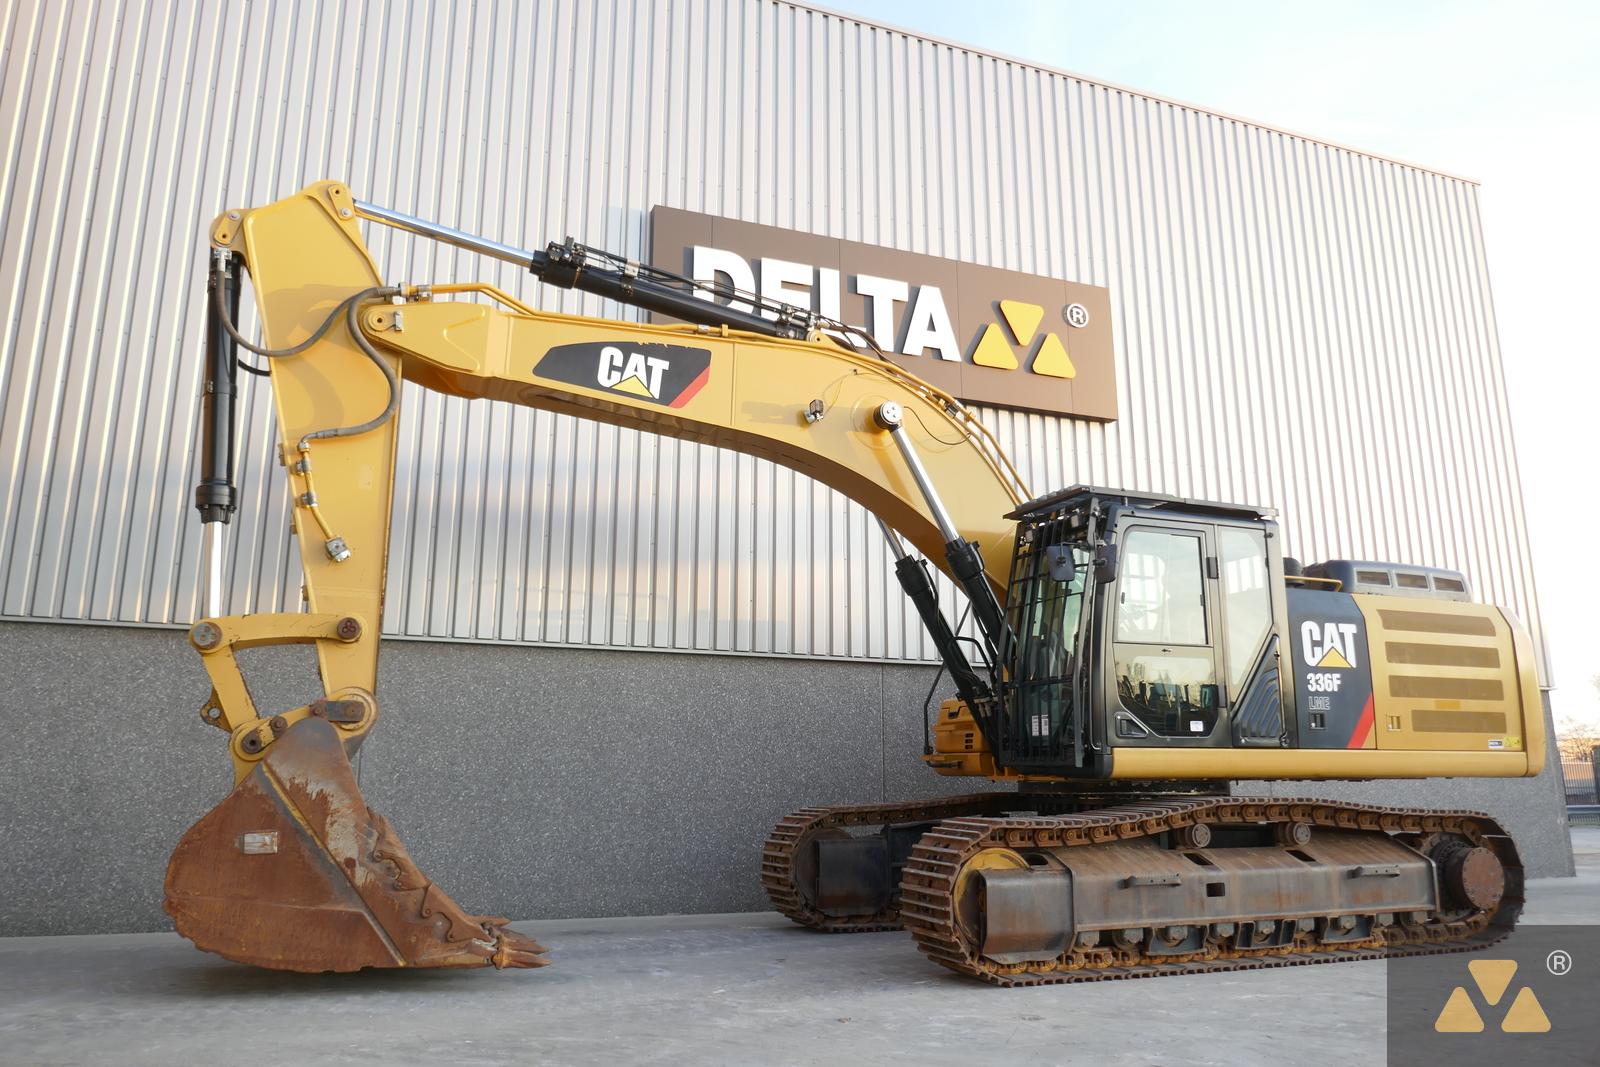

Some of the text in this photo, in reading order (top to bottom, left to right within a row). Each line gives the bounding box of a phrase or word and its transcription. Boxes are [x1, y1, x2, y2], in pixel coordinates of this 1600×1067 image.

[693, 245, 962, 362] DELTA
[597, 346, 670, 400] CAT
[1301, 620, 1358, 669] CAT
[1306, 672, 1342, 692] 336F
